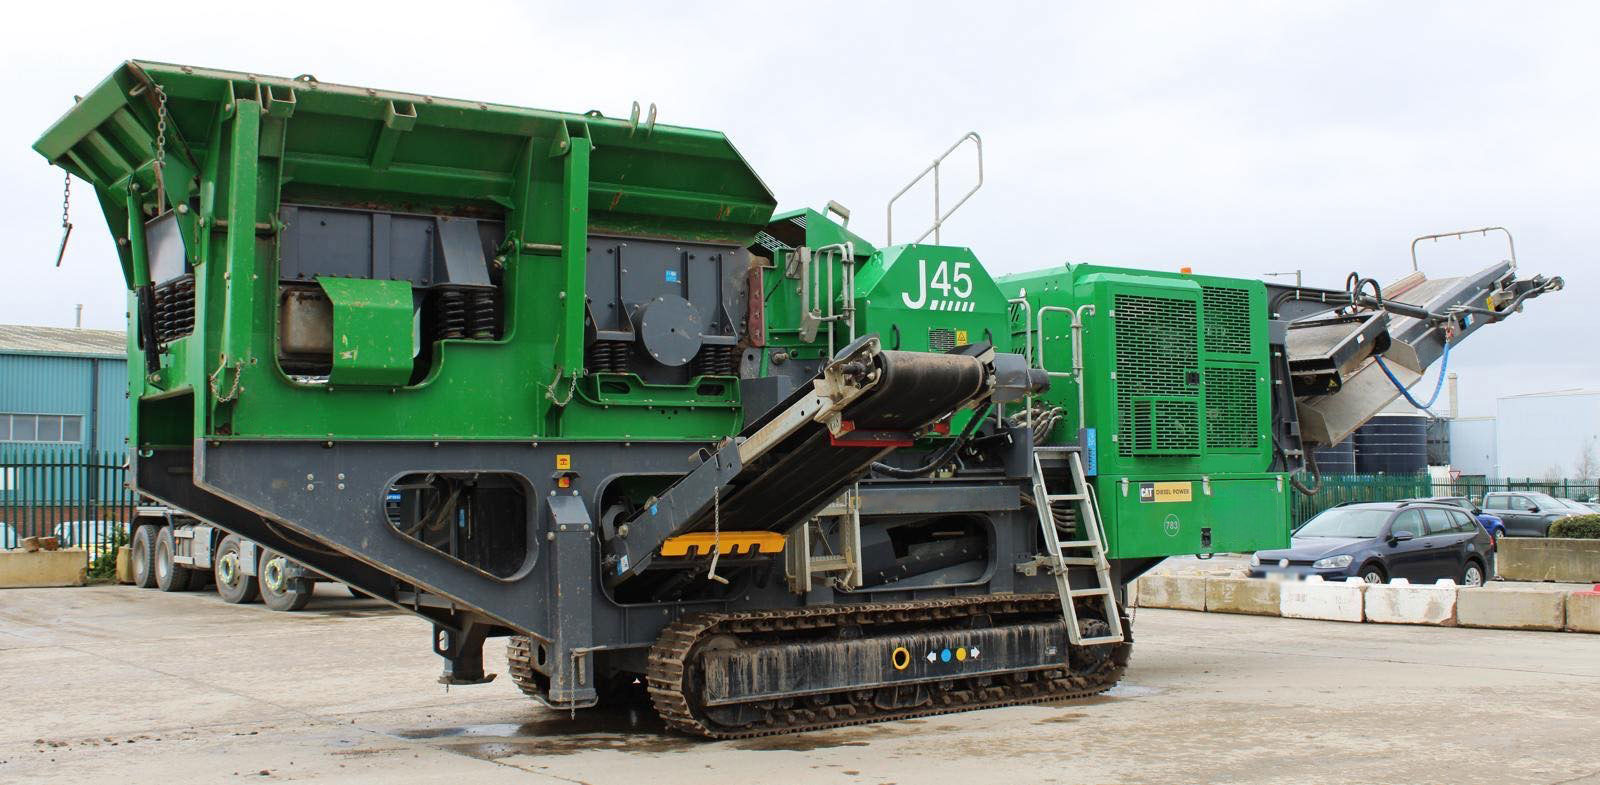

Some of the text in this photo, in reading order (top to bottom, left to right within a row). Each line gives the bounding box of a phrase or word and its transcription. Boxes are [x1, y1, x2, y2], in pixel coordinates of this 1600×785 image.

[901, 259, 973, 309] J45
[1141, 487, 1154, 498] CAT
[1165, 520, 1178, 530] 783
